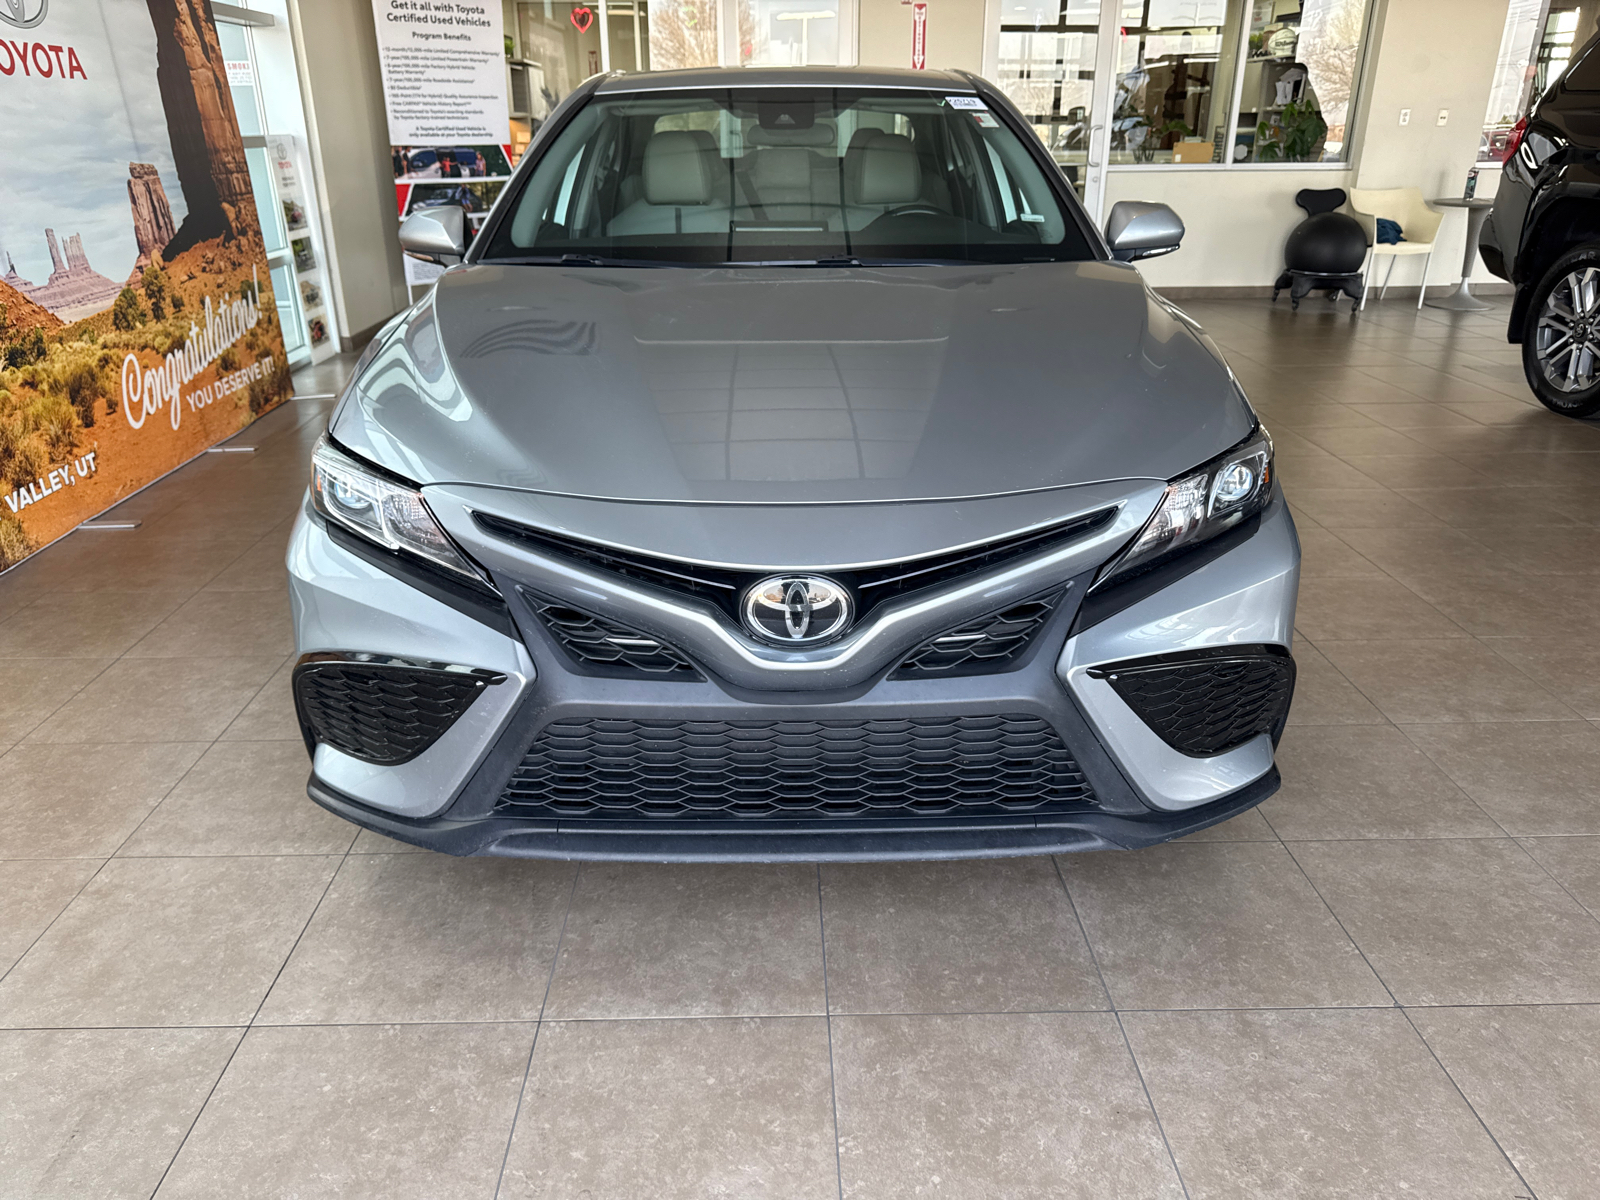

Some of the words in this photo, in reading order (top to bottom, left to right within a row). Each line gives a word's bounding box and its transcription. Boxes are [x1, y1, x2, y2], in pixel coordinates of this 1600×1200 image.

[387, 13, 428, 24] Certified
[430, 15, 453, 25] Used
[454, 17, 491, 27] Vehicles
[391, 1, 409, 9] Get
[410, 2, 418, 10] it
[420, 2, 431, 11] all
[433, 3, 454, 13] with
[456, 4, 485, 15] Toyota
[412, 31, 442, 40] Program
[444, 32, 471, 41] Benefits
[0, 38, 88, 80] OYOTA
[122, 263, 263, 431] Congratulations!
[186, 388, 214, 413] YOU
[215, 362, 262, 400] DESERVE
[260, 356, 276, 377] IT!
[4, 464, 76, 514] VALLEY,
[74, 452, 96, 477] UT
